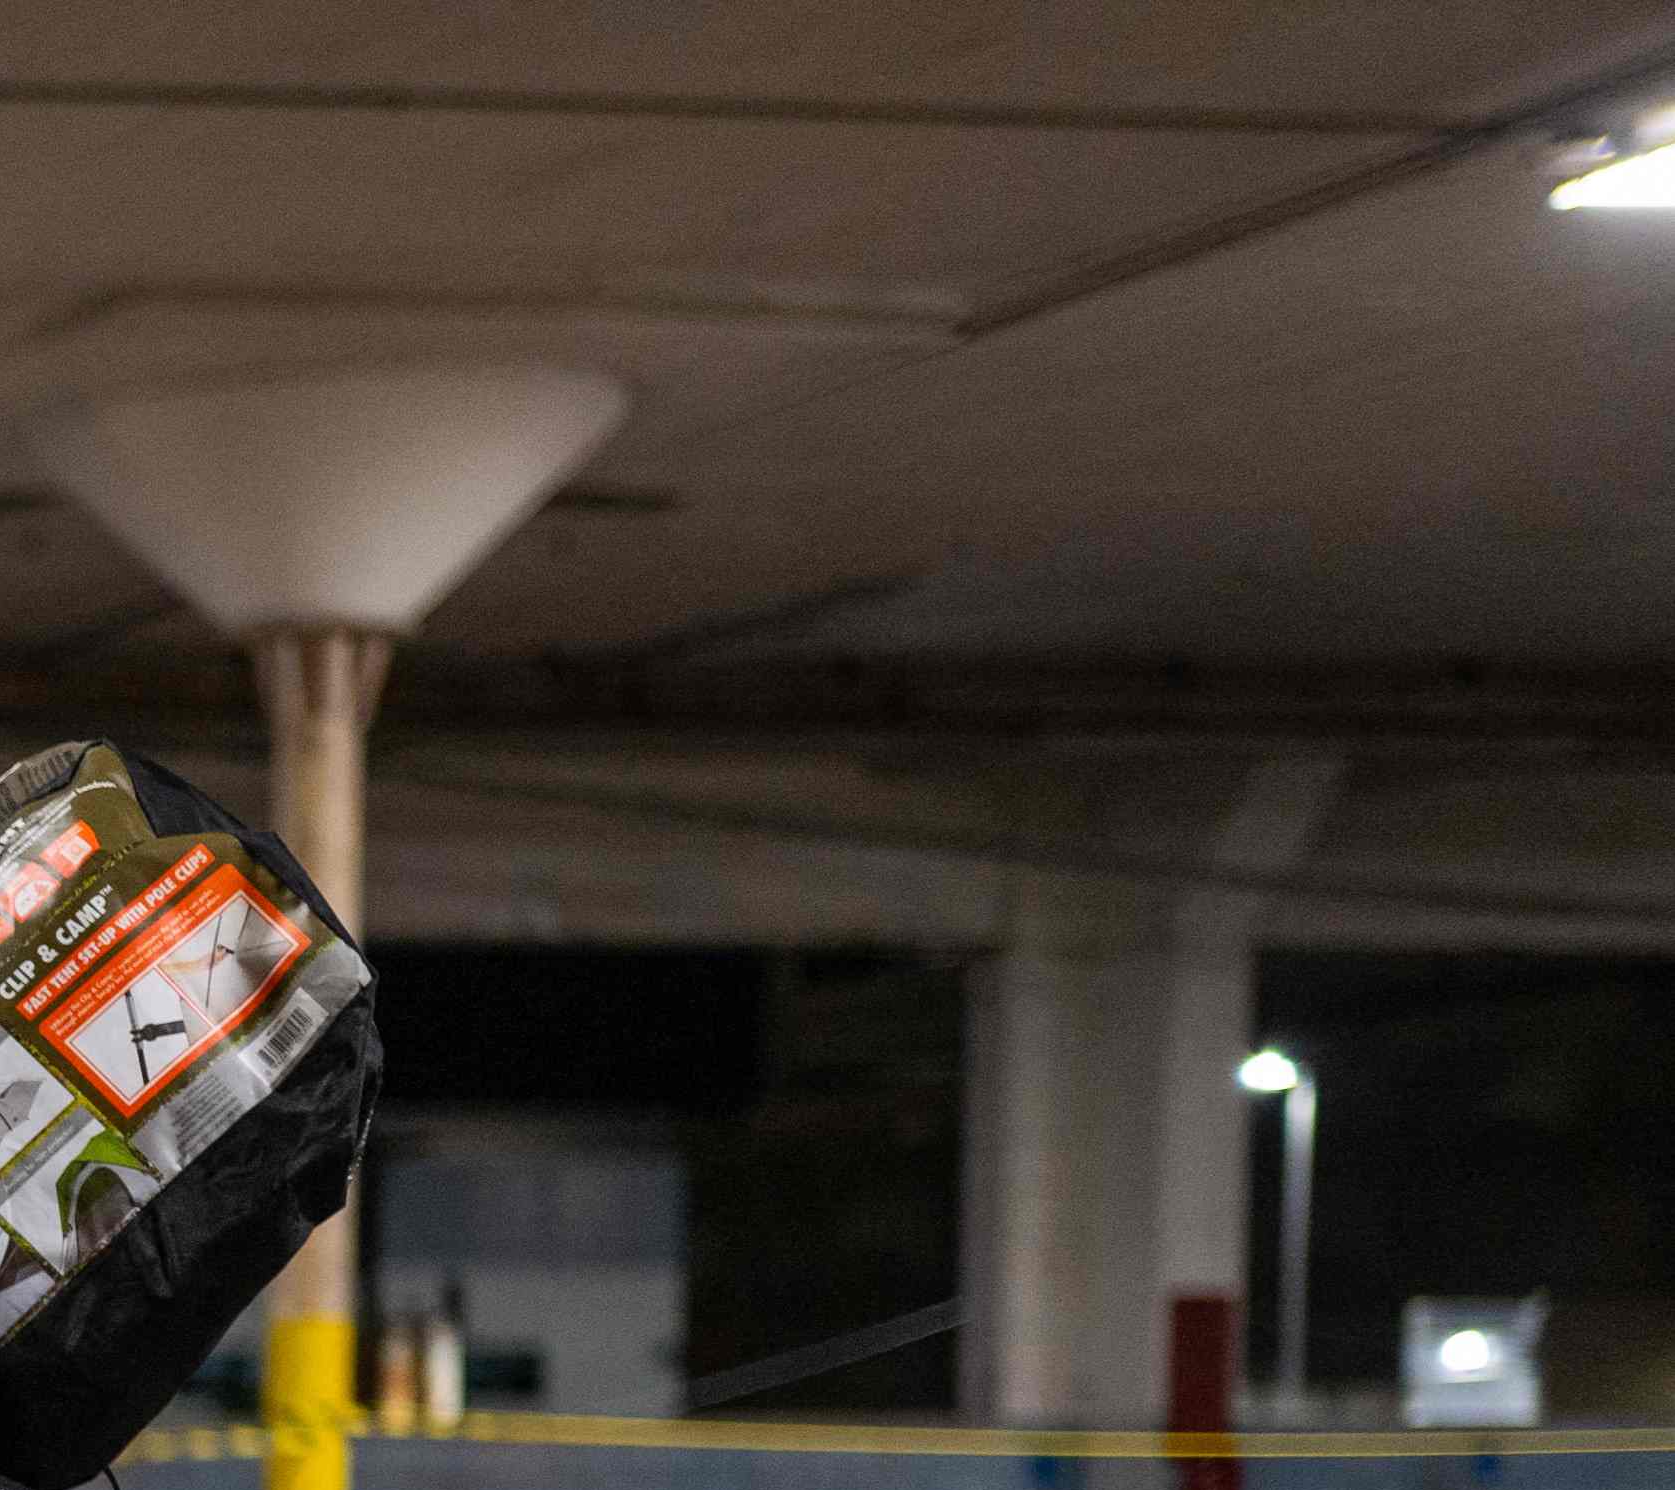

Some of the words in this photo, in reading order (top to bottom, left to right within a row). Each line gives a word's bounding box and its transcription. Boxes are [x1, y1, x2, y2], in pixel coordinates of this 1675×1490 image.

[23, 985, 52, 1013] FAST
[77, 926, 117, 964] SET-UP
[115, 902, 147, 930] WITH
[144, 877, 176, 907] POLE
[174, 849, 208, 881] CLIPS
[37, 944, 59, 963] &
